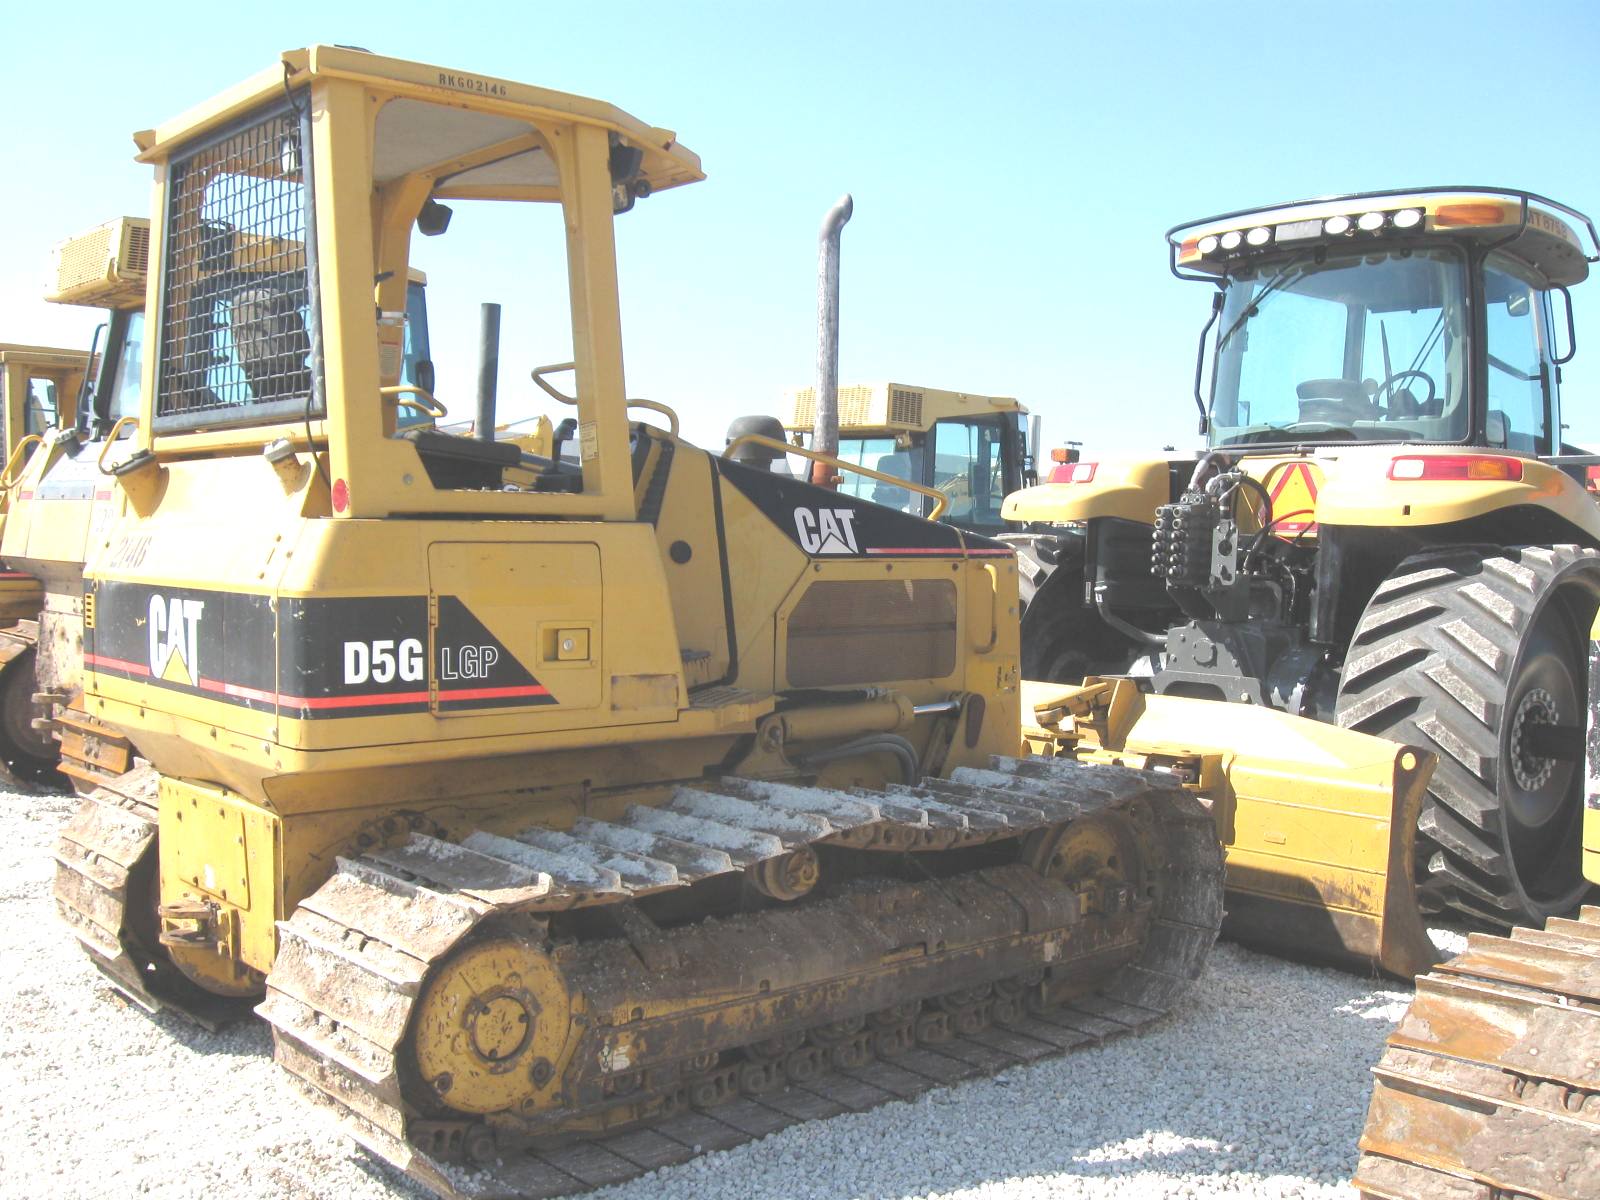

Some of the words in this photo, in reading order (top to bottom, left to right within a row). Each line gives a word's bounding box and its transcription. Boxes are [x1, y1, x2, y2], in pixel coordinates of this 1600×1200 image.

[439, 73, 507, 96] RKG02146
[793, 506, 860, 554] CAT
[149, 594, 205, 687] CAT
[344, 638, 424, 684] D5G
[442, 645, 499, 680] LGP
